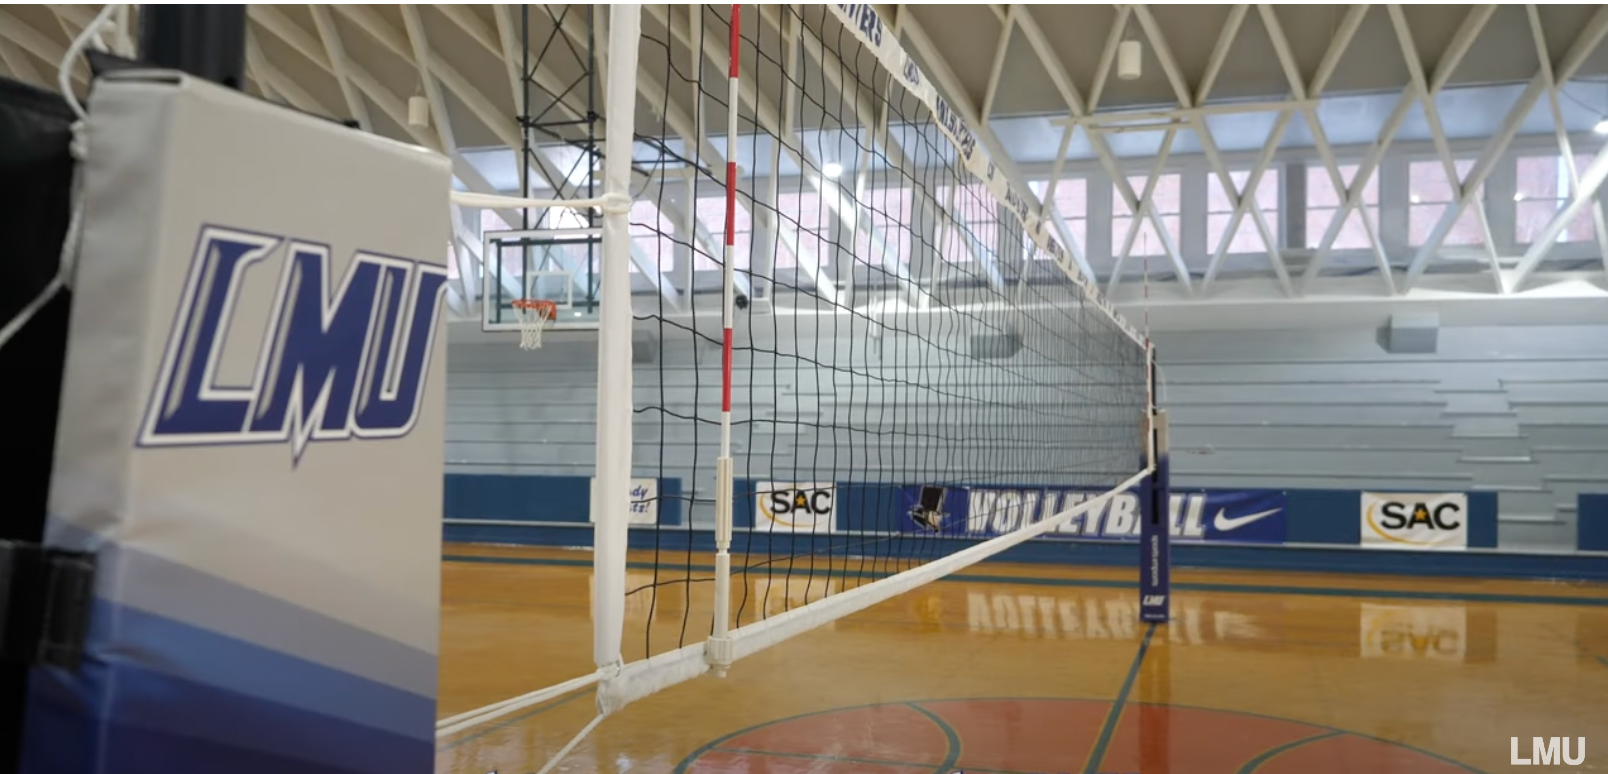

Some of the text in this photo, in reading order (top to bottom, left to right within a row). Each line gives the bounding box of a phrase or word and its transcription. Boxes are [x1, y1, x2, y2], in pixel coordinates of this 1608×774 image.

[136, 223, 447, 469] LMU
[770, 490, 831, 514] SAC
[968, 490, 1206, 537] VOLLEYBLL
[1380, 501, 1460, 530] SAC
